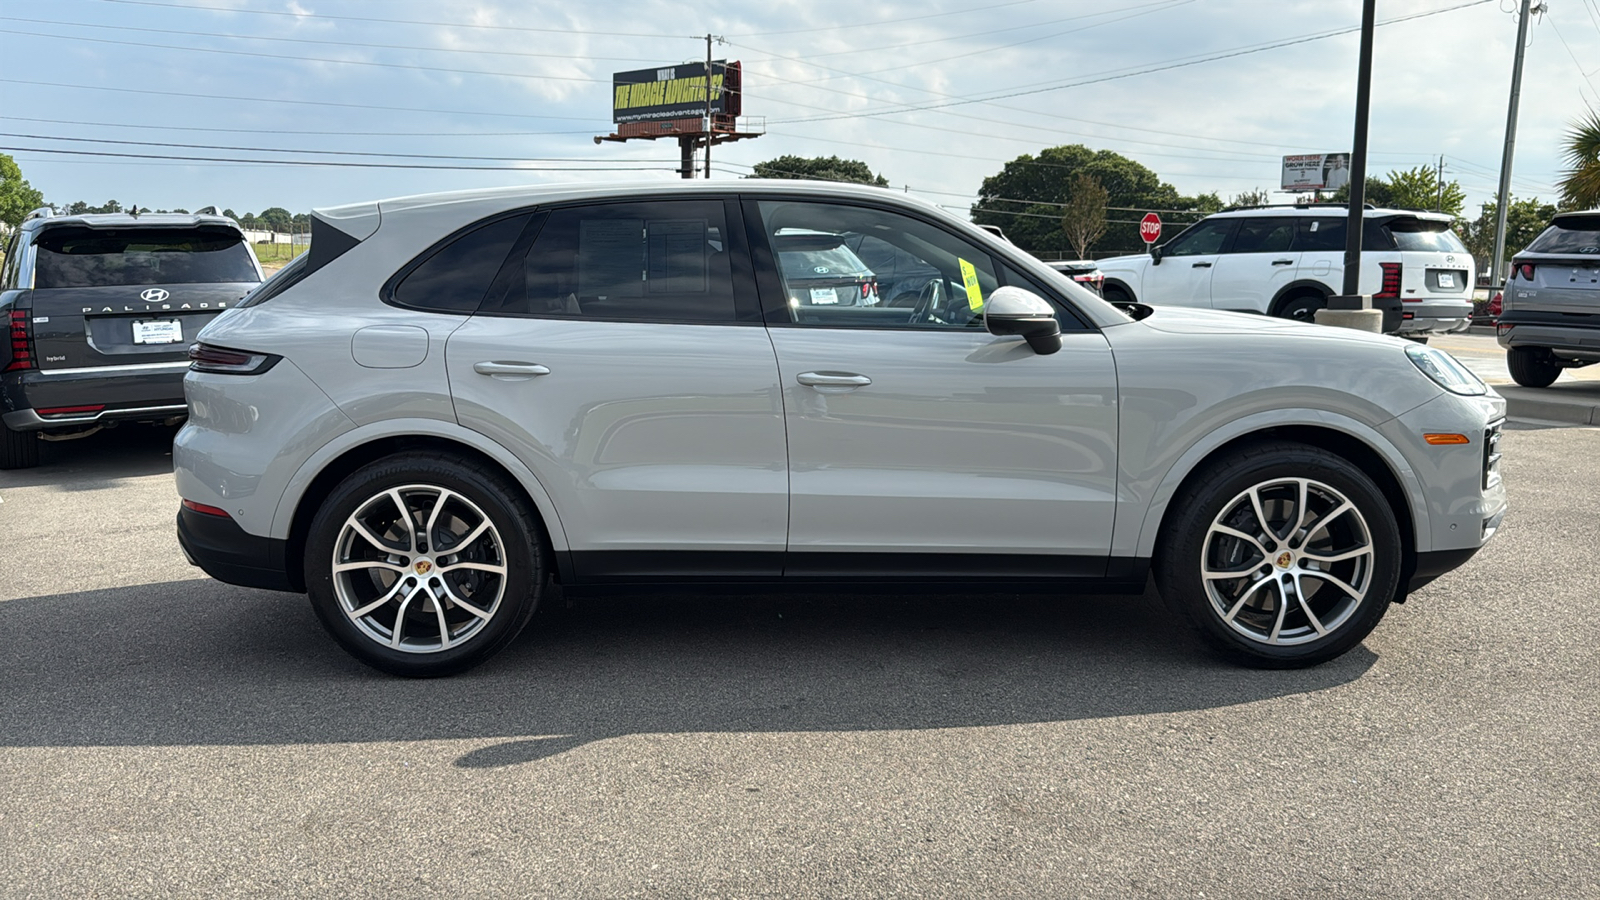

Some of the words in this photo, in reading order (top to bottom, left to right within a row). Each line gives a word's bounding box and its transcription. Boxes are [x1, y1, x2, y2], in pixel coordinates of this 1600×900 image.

[614, 85, 630, 109] THE
[629, 81, 665, 108] MIRACLE
[1142, 222, 1160, 234] STOP
[82, 302, 227, 313] PALISADE
